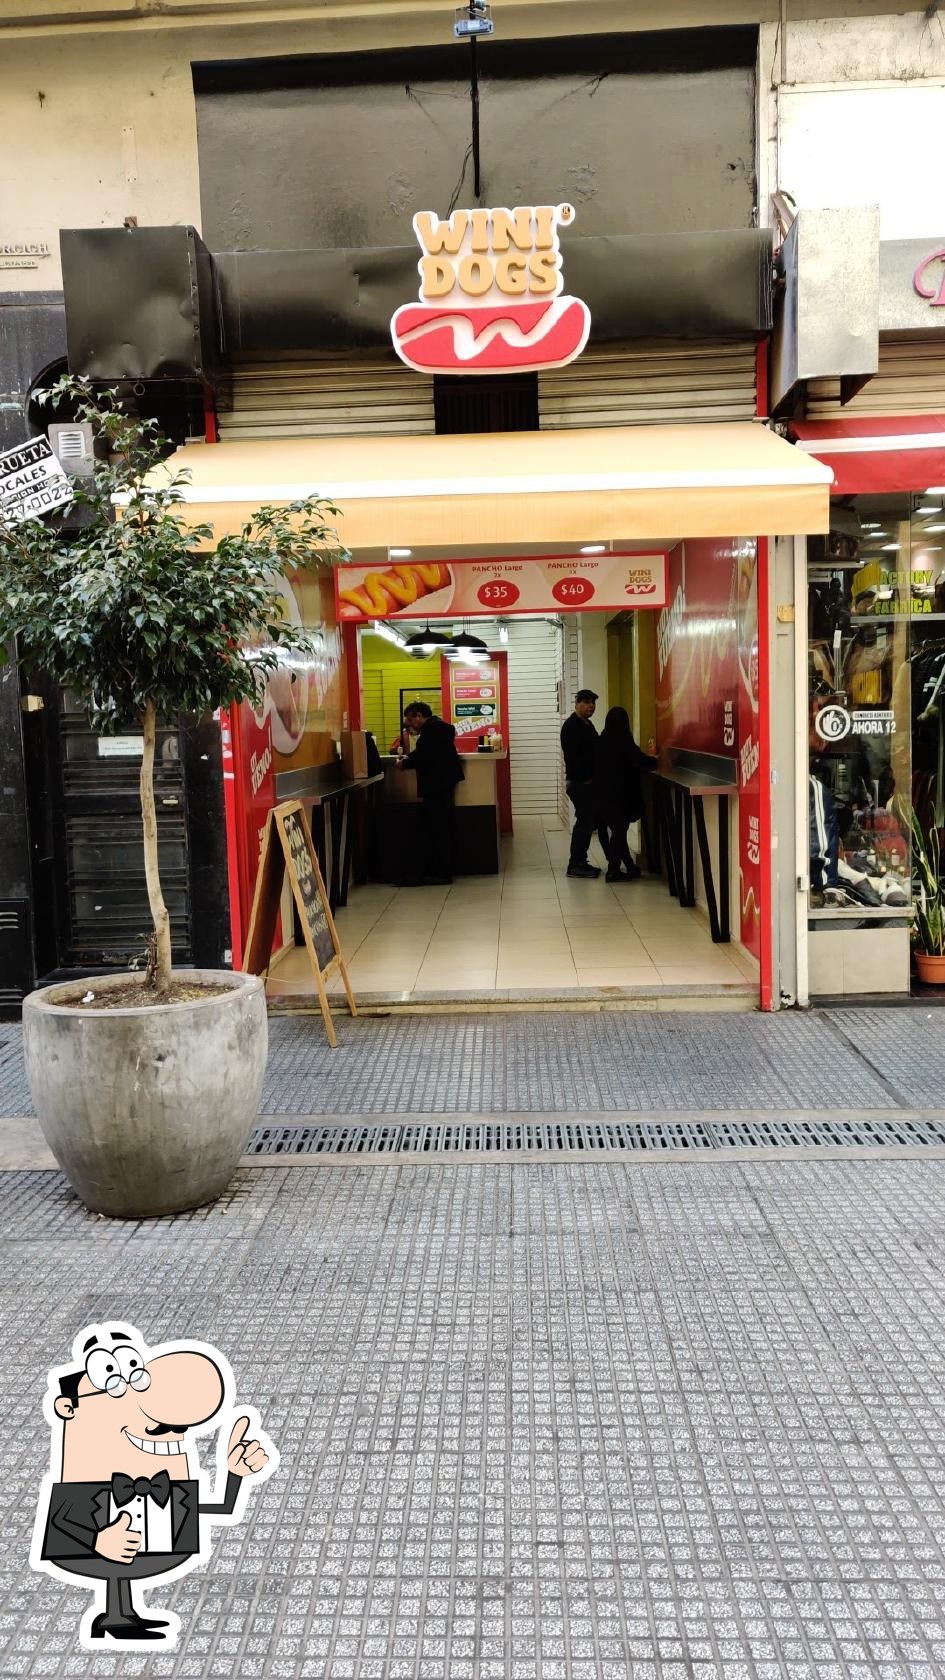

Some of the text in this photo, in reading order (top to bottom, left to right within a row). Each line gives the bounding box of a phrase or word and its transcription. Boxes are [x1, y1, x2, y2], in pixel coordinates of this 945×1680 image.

[416, 207, 554, 255] WINI
[422, 251, 558, 298] DOGS
[629, 576, 653, 584] DOGS
[484, 586, 508, 598] $35
[561, 583, 585, 596] $40
[874, 599, 933, 615] FABRICA
[852, 721, 897, 735] AHORA 12
